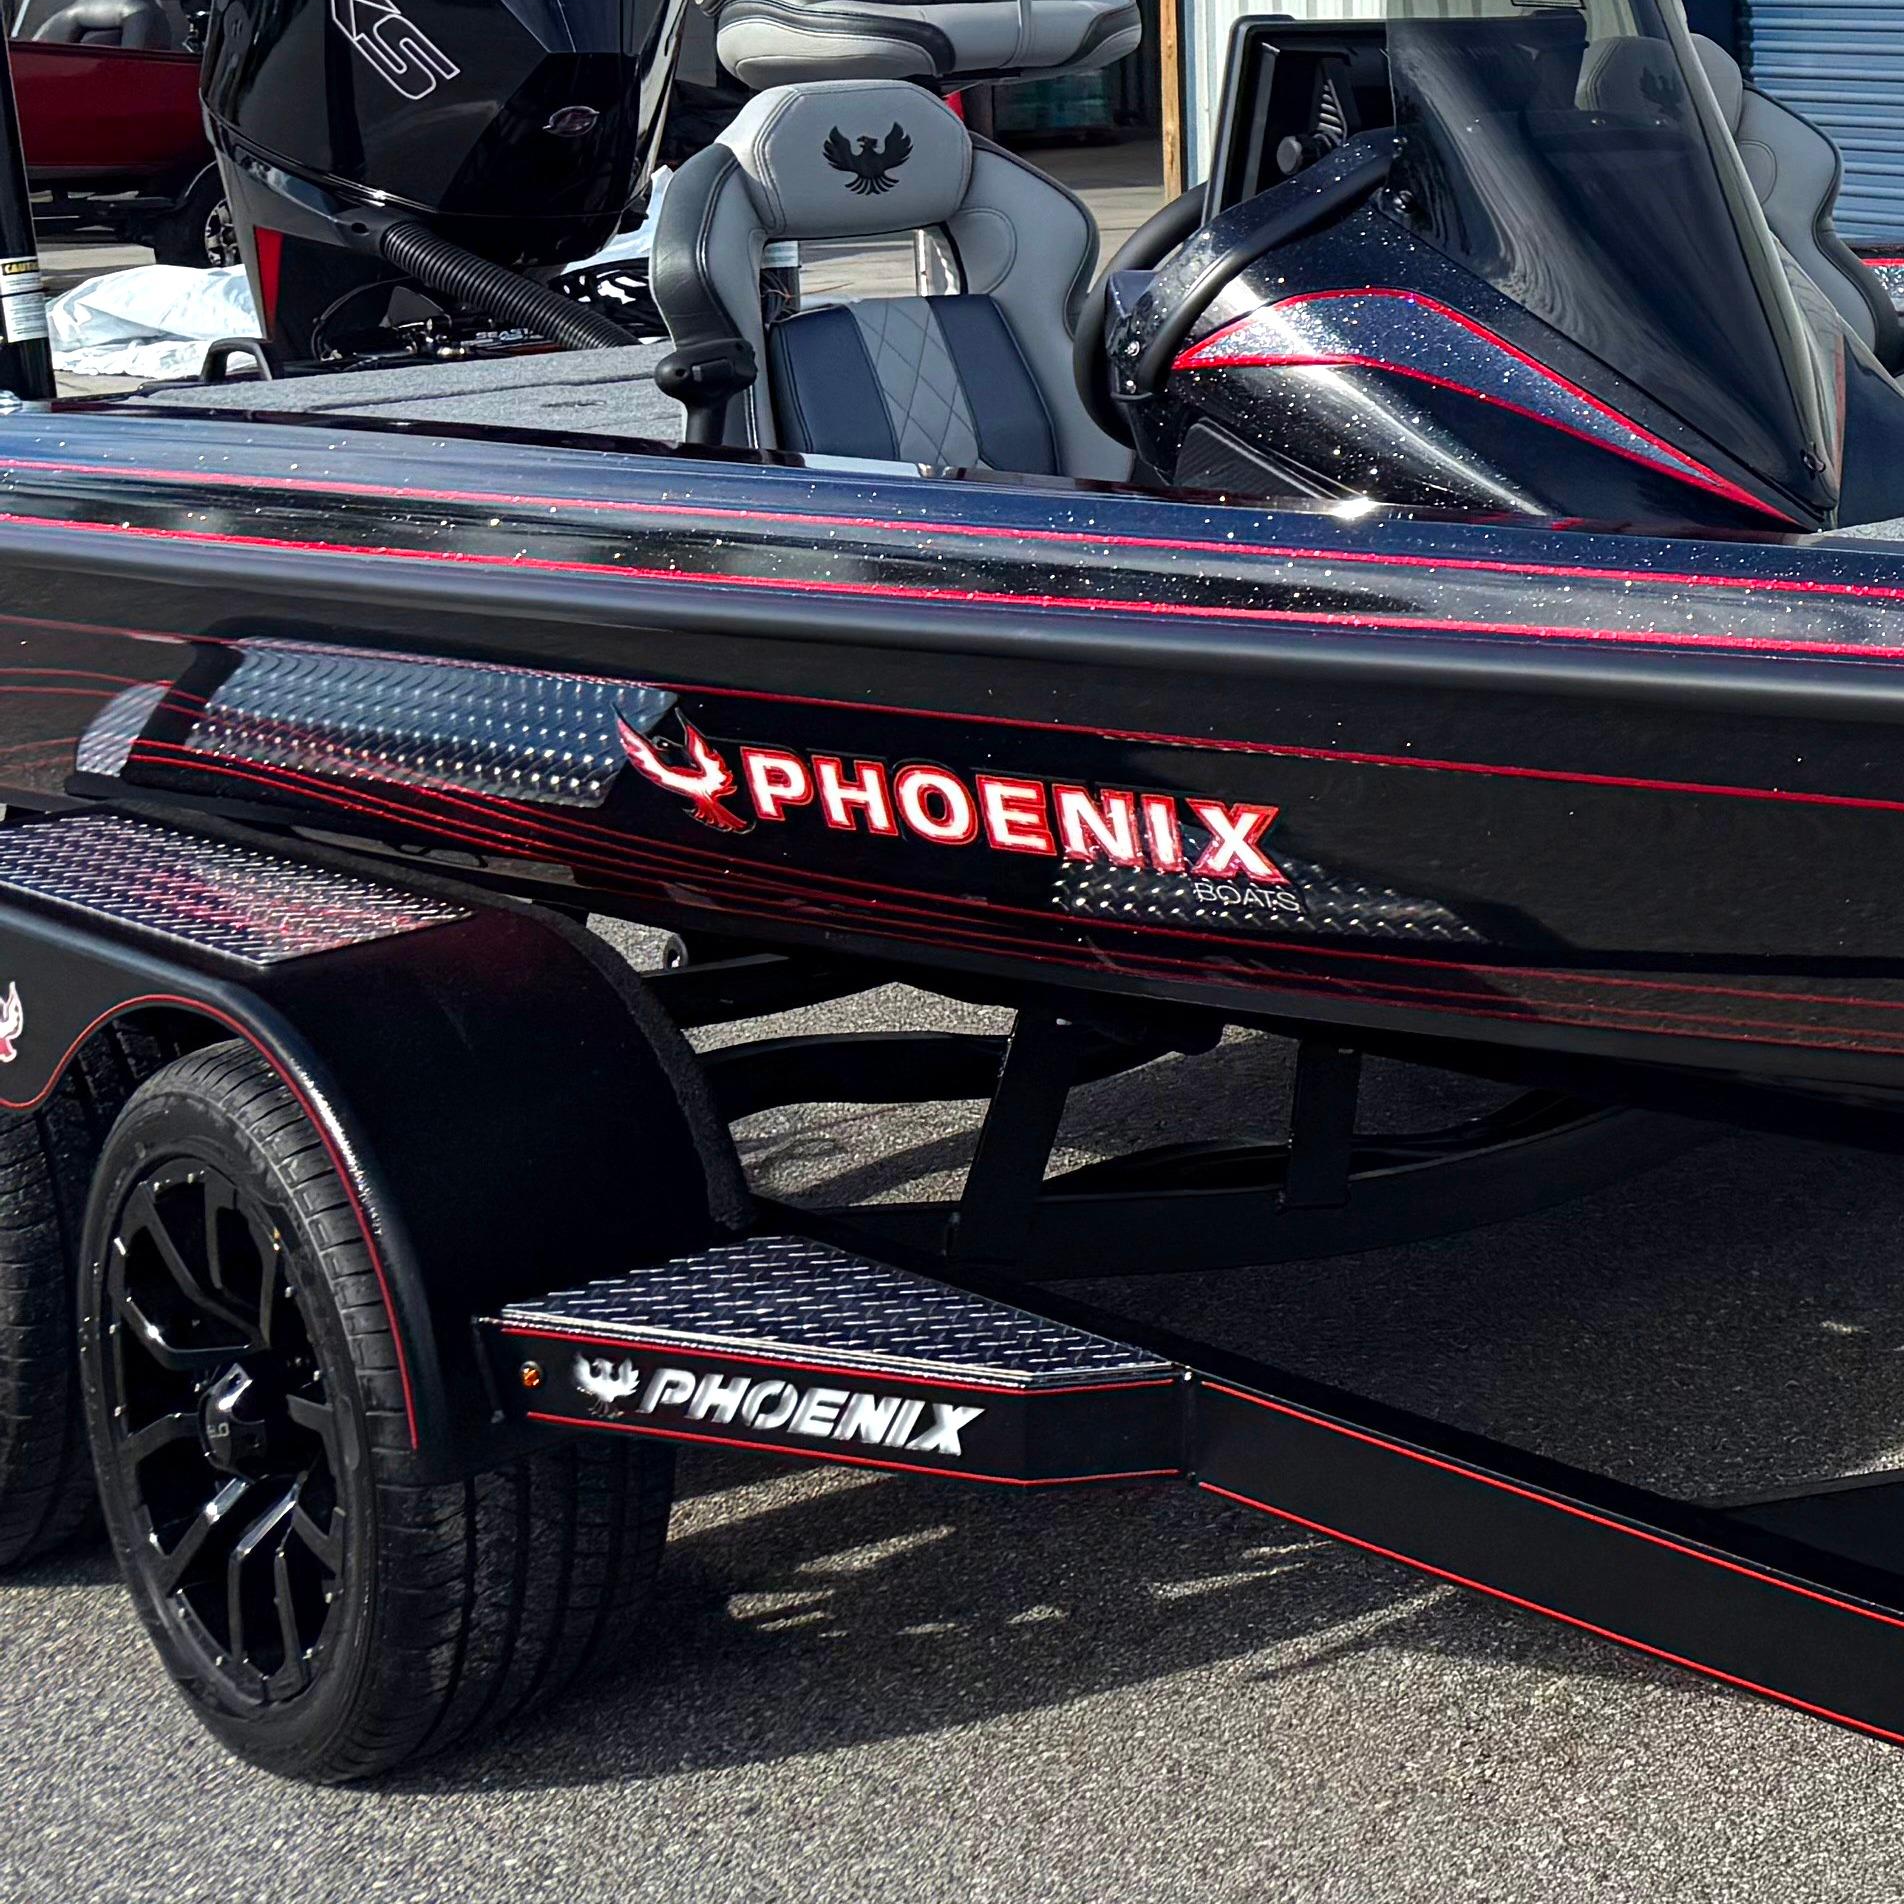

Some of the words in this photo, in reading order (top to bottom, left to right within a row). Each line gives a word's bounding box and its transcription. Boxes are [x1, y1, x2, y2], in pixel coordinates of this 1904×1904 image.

[739, 745, 1291, 883] PHOENIX
[1194, 881, 1301, 913] BOATS
[636, 1368, 987, 1456] PHOENIX
